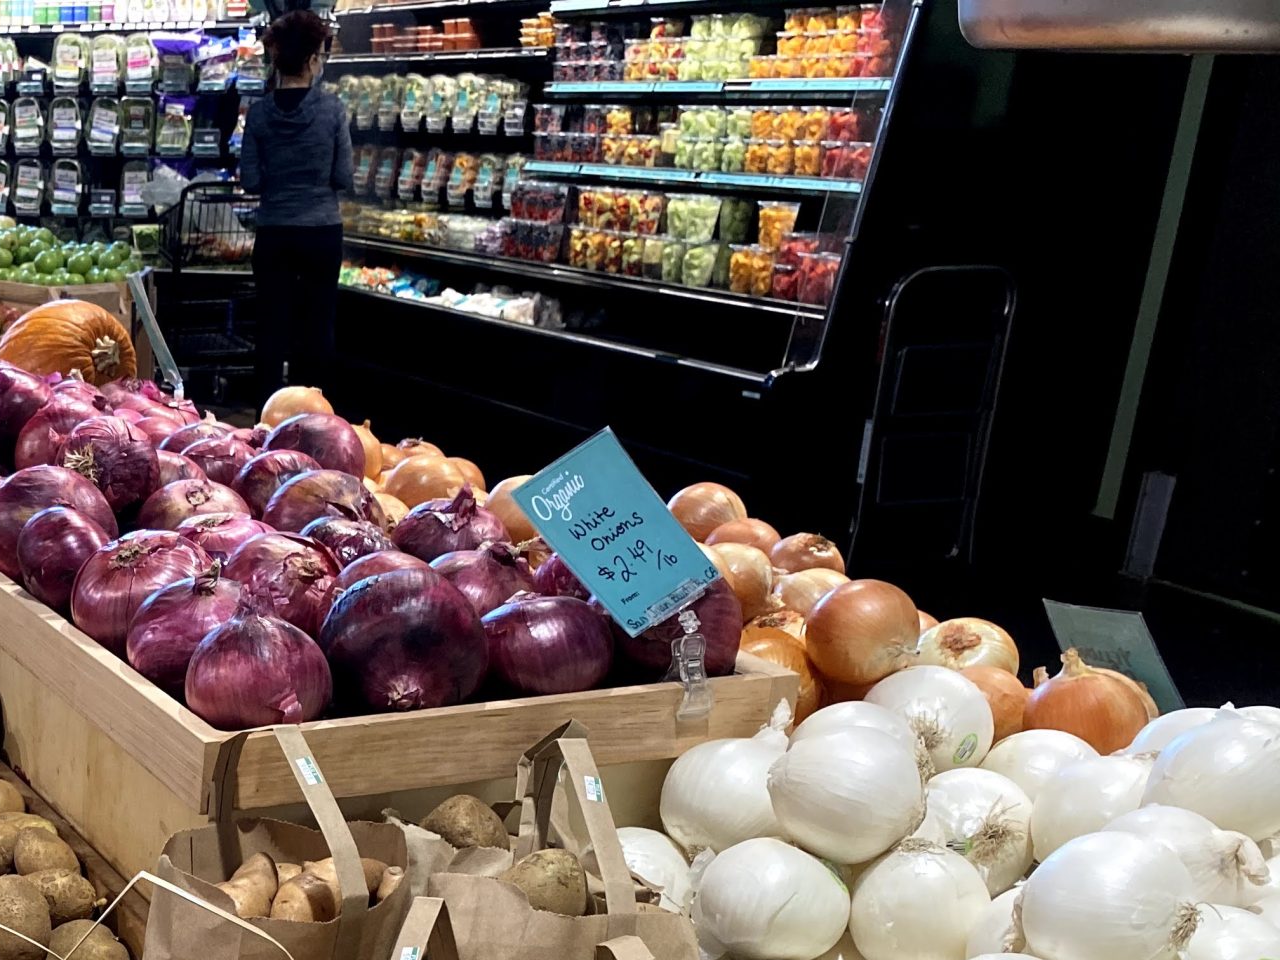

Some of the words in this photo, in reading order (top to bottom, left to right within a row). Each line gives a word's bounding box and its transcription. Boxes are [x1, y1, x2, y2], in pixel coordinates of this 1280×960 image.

[531, 471, 584, 521] Organic
[569, 506, 615, 540] White
[591, 512, 644, 551] Onions
